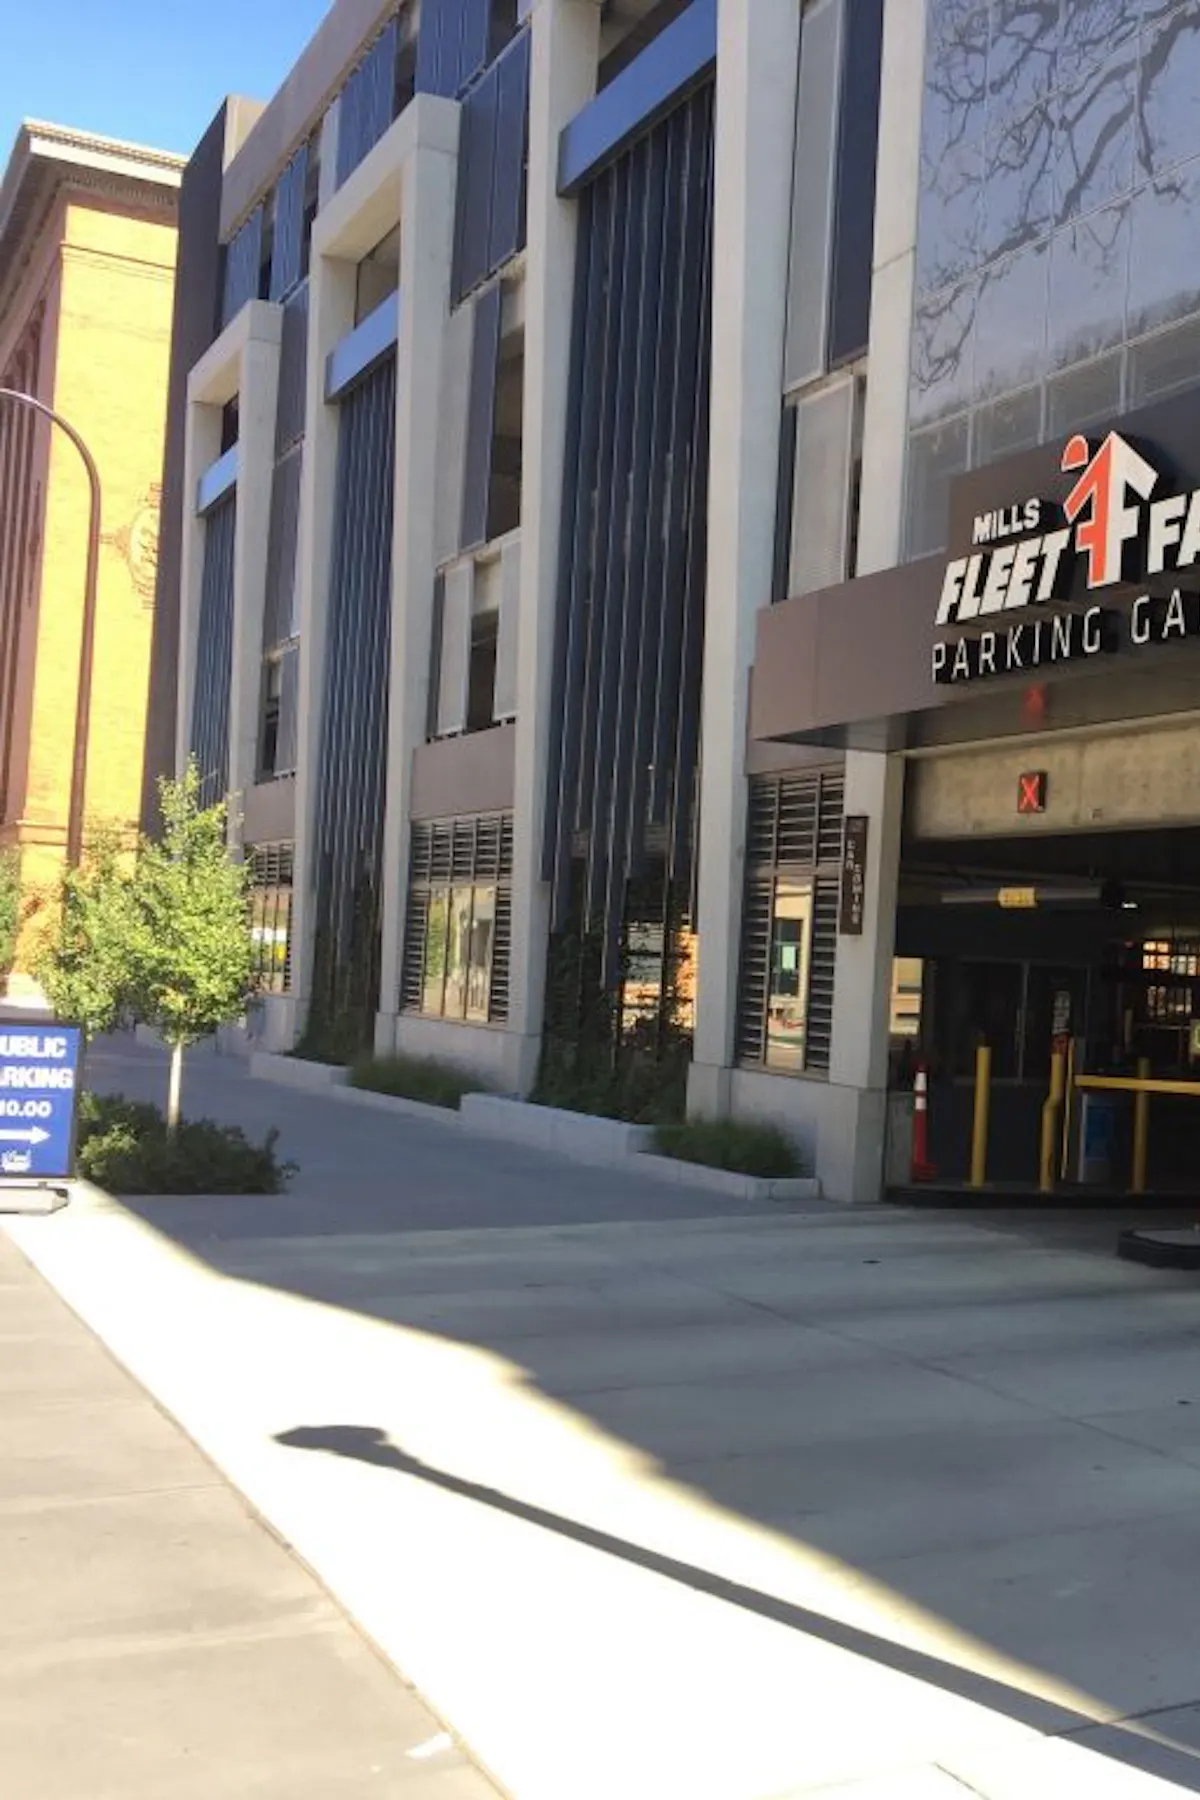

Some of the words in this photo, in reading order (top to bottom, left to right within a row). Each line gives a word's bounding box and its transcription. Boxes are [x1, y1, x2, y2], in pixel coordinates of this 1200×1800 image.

[972, 498, 1040, 545] MILLS
[935, 528, 1071, 626] FLEET
[931, 606, 1101, 682] PARKING
[0, 1035, 67, 1058] UBLIC
[0, 1066, 74, 1088] RKING
